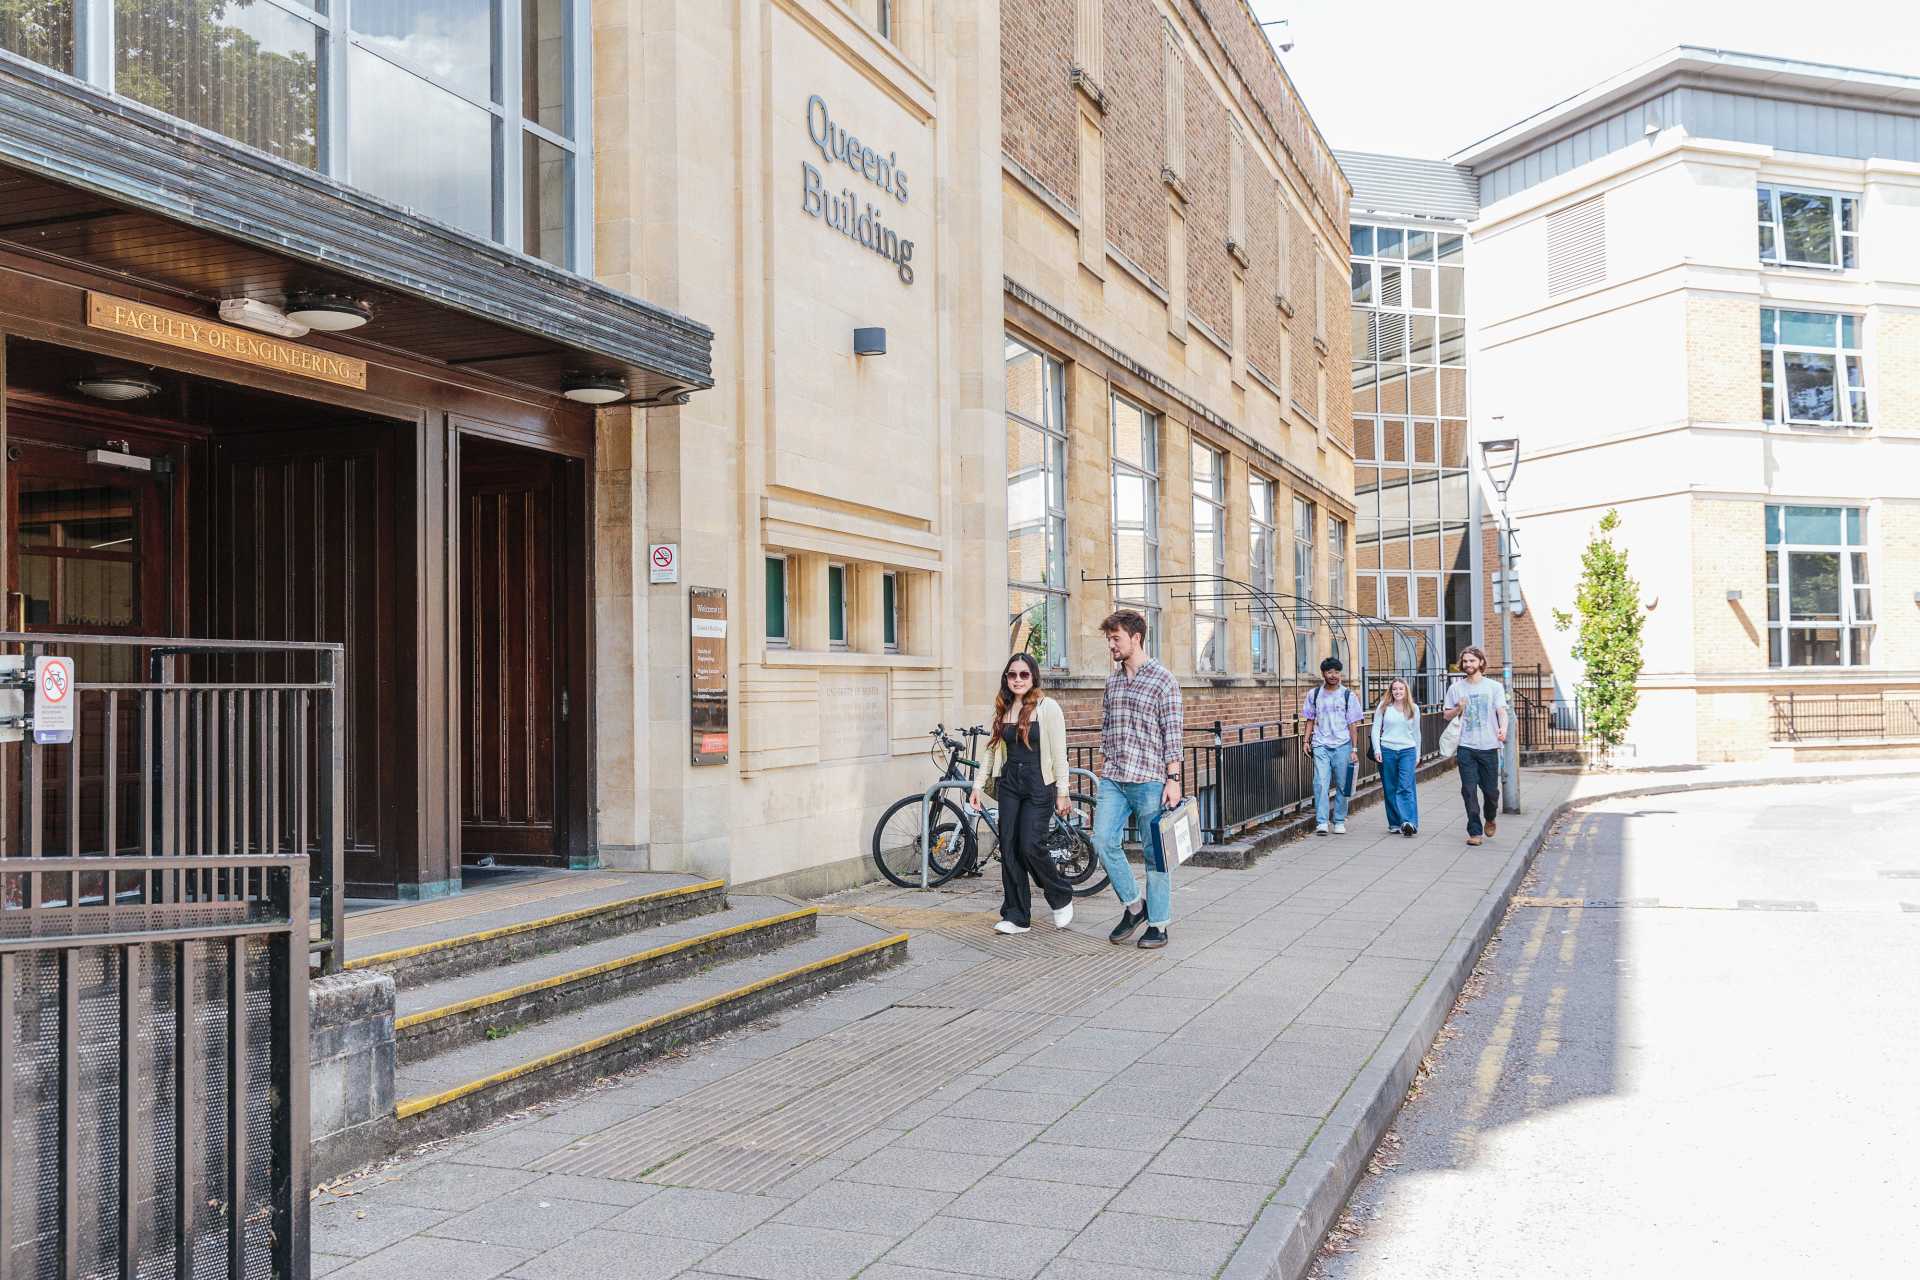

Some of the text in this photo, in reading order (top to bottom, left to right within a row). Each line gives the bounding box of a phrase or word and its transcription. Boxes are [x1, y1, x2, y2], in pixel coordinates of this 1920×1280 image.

[808, 95, 909, 204] Queen's
[802, 160, 914, 285] Building
[114, 306, 351, 379] FACULTY OF ENGINEERING
